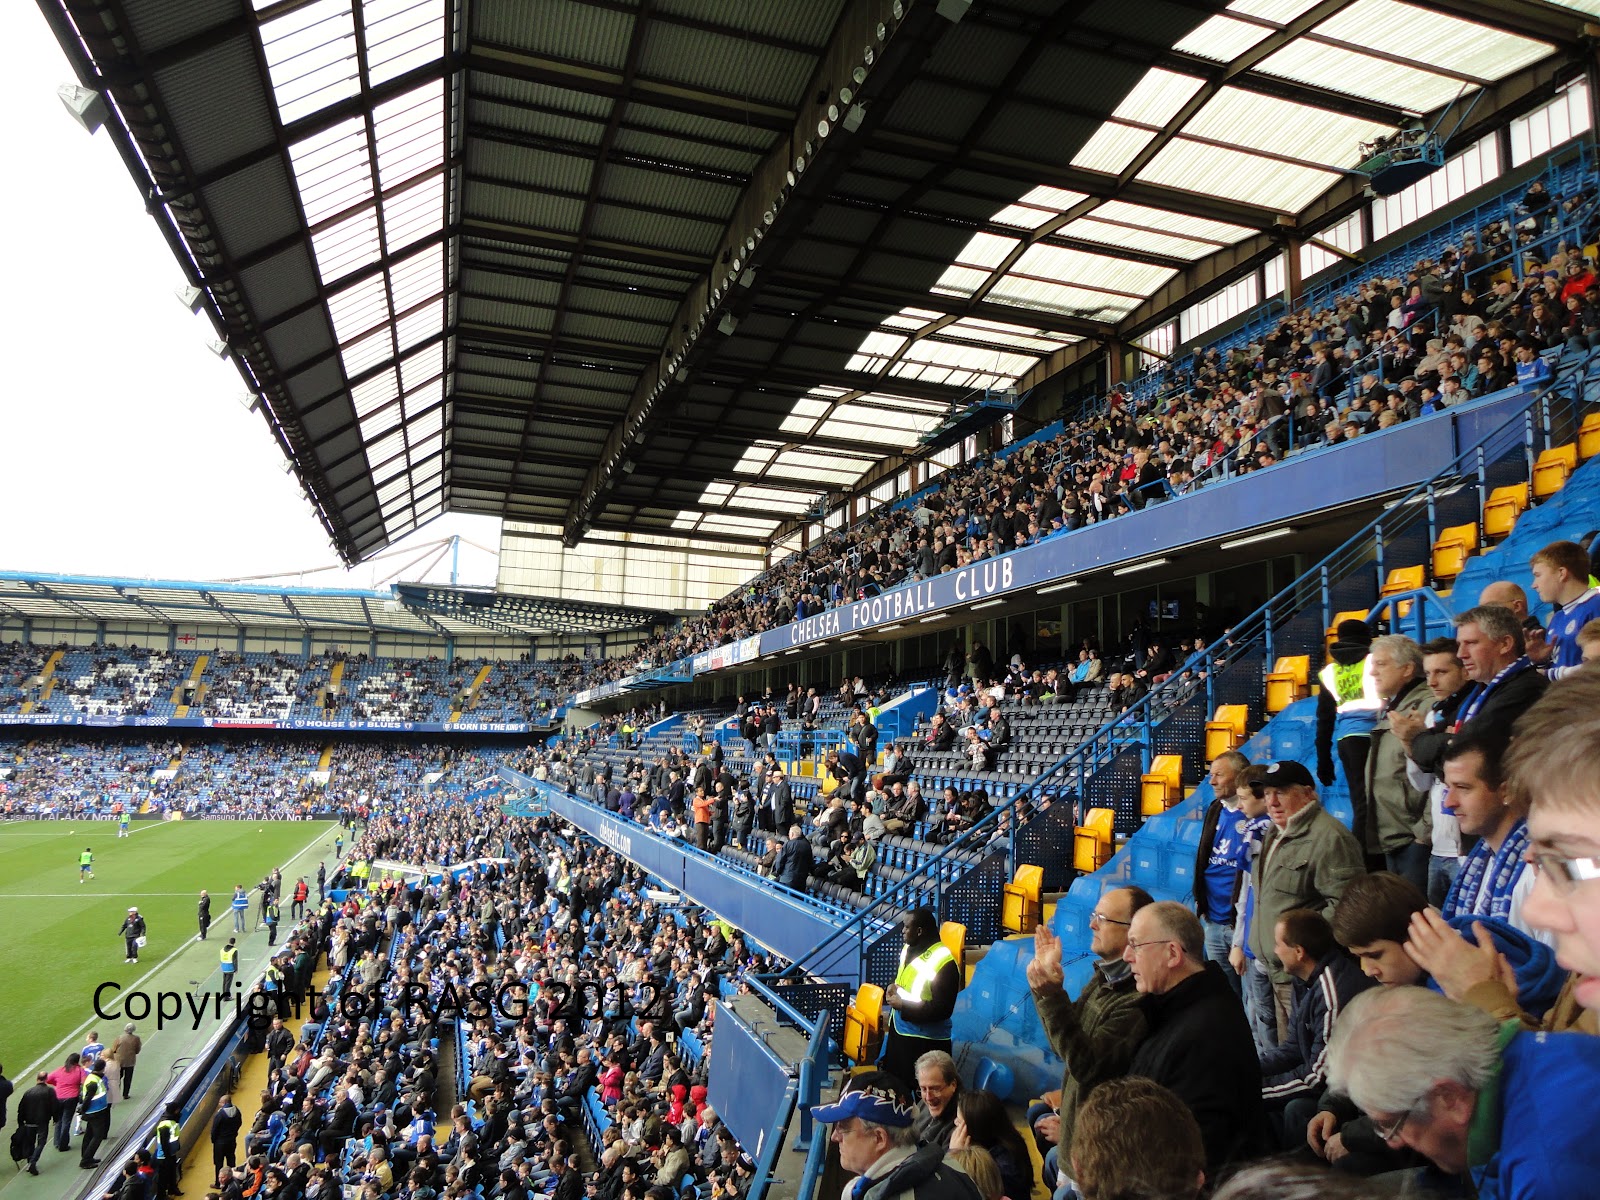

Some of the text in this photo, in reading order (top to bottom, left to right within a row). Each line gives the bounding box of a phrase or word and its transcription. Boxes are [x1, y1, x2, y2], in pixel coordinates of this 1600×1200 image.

[791, 557, 1013, 645] CHELSEA FOOTBALL CLUB
[306, 720, 345, 728] HOUSE
[453, 722, 478, 730] BORN
[489, 723, 505, 731] THE
[600, 818, 631, 855] chelseafc.com
